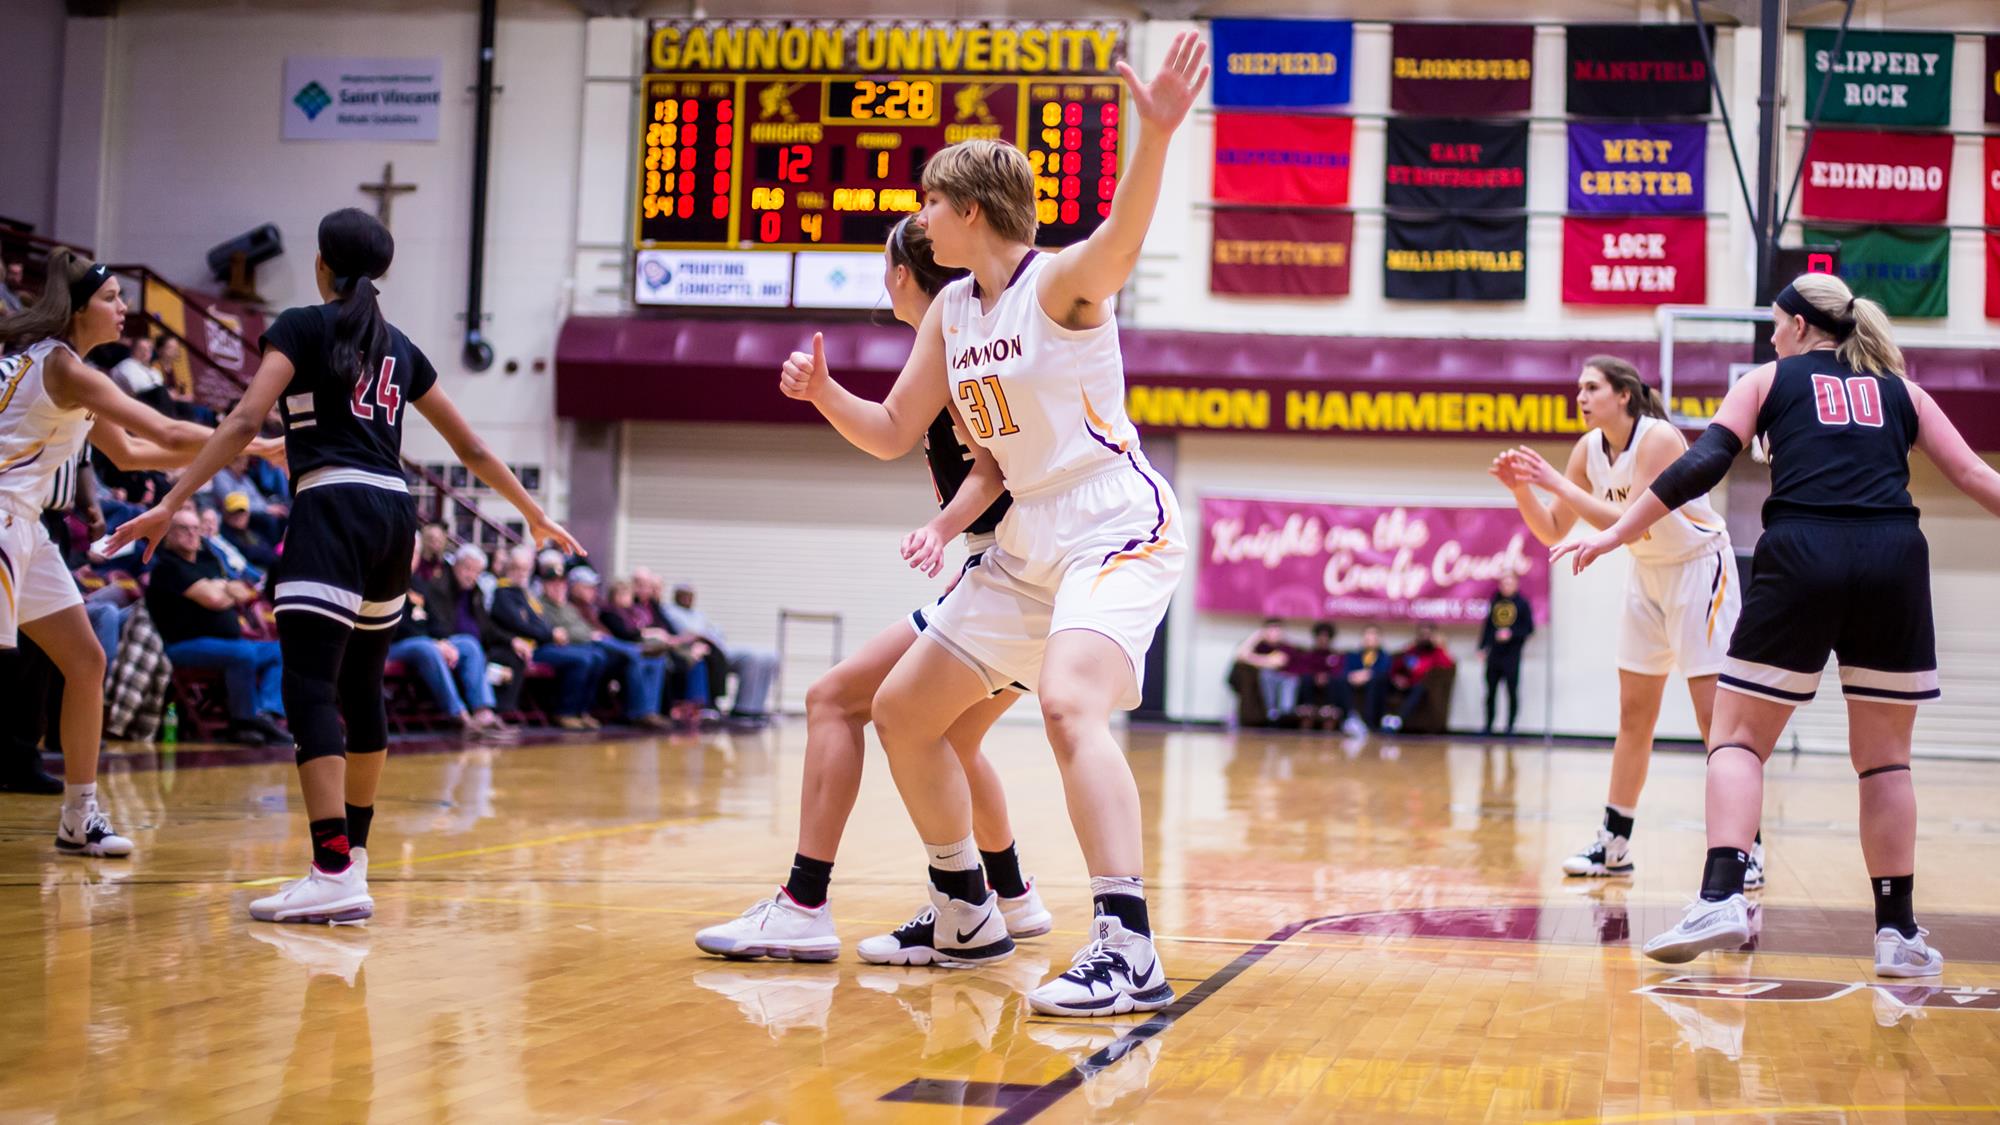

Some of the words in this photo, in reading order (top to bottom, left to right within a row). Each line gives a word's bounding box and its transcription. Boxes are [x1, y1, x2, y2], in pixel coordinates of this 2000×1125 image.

[651, 27, 843, 69] GANNON
[856, 27, 1118, 71] UNIVERSITY
[1228, 52, 1337, 75] SHEPHERD
[1574, 60, 1705, 81] MANSFIELD
[851, 80, 934, 120] 2:28
[1844, 83, 1908, 107] ROCK
[778, 145, 813, 183] 12
[877, 151, 889, 179] 1
[1429, 142, 1481, 162] EAST
[1602, 139, 1673, 163] WEST
[1580, 171, 1693, 196] CHESTER
[1811, 161, 1943, 191] EDINBORO
[760, 212, 781, 242] 0
[801, 213, 822, 242] 4
[1602, 233, 1666, 259] LOCK
[1591, 265, 1677, 292] HAVEN
[350, 351, 401, 426] 24
[1811, 373, 1884, 428] 00
[958, 374, 1020, 439] 31
[1128, 385, 1270, 430] NNON
[1211, 513, 1323, 569] Knight
[1325, 526, 1369, 552] on
[1373, 507, 1430, 552] the
[1323, 548, 1430, 600] Comfy
[1432, 533, 1532, 587] Couch
